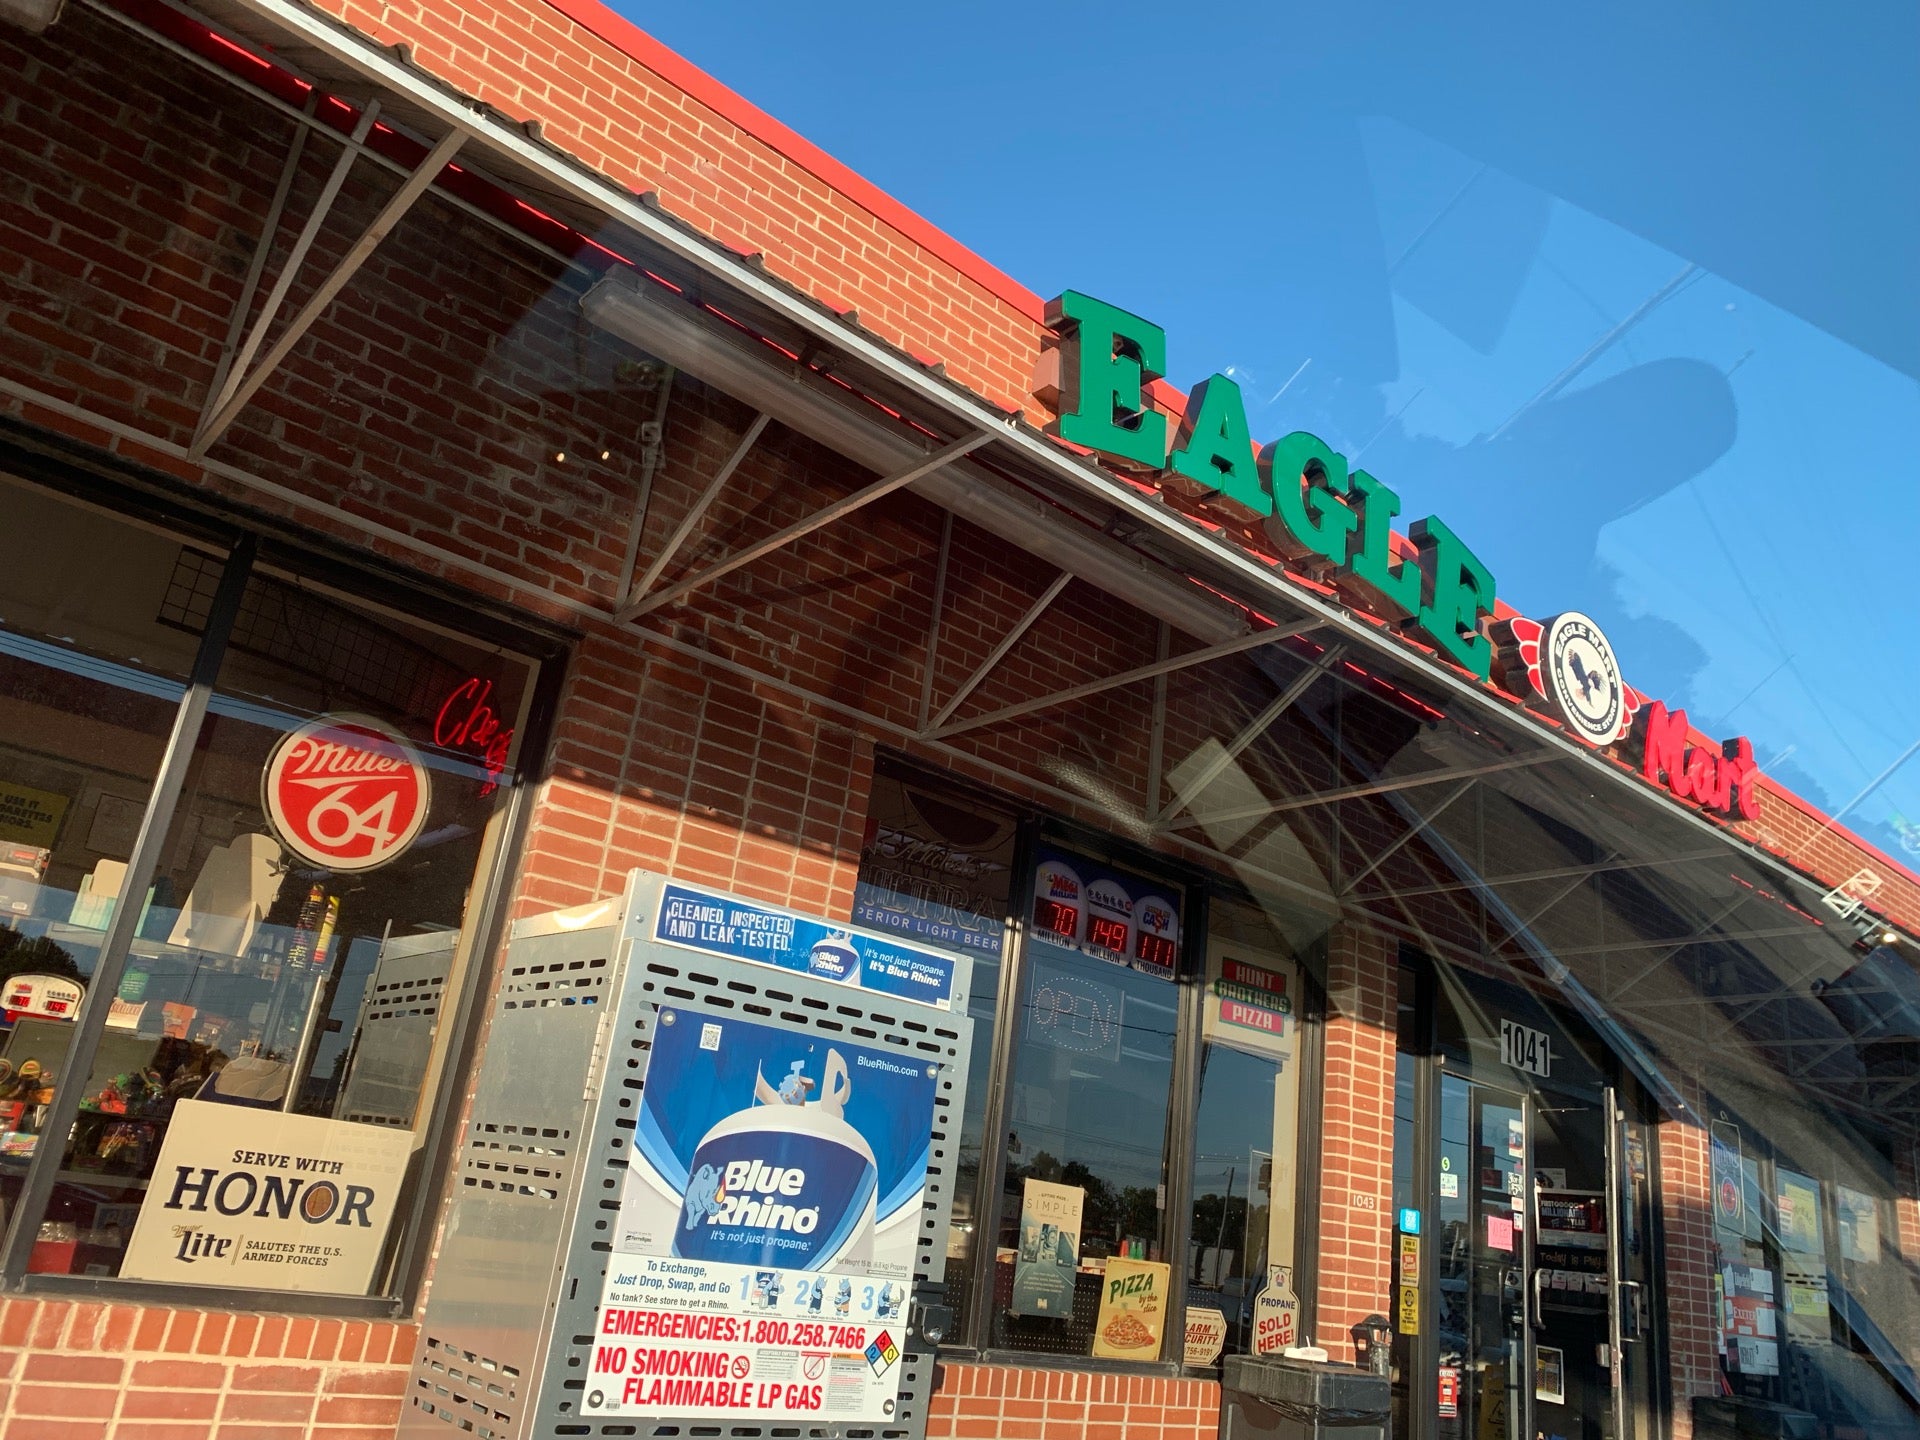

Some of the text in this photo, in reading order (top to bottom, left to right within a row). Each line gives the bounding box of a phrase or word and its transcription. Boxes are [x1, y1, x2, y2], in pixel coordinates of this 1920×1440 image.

[1046, 288, 1497, 683] EAGLE
[1555, 622, 1617, 688] EAGLE MART
[1556, 667, 1617, 732] CONVENIENCE STORE
[287, 737, 411, 775] Miller
[1643, 699, 1762, 821] Mart
[307, 784, 398, 855] 64
[670, 901, 794, 937] CLEANED, INSPECTED,
[1052, 903, 1075, 936] 70
[669, 919, 791, 952] AND LEAK-TESTED.
[916, 921, 958, 940] LIGHT
[964, 933, 1000, 951] BEER
[1037, 928, 1070, 948] MILLION
[1092, 919, 1125, 952] 149
[819, 951, 840, 962] Blue
[865, 947, 946, 978] It's not just propane.
[1089, 945, 1120, 964] MILLION
[1141, 935, 1172, 966] 111
[815, 960, 845, 973] Rhino
[869, 960, 885, 973] It's
[886, 965, 909, 979] Blue
[1136, 960, 1172, 979] THOUSAND
[1236, 965, 1274, 989] HUNT
[1219, 981, 1288, 1012] BROTHERS
[1036, 987, 1112, 1042] OPEN
[1232, 1004, 1272, 1030] PIZZA
[1503, 1022, 1549, 1076] 1041
[857, 1055, 919, 1078] BlueRhino.com
[232, 1149, 344, 1175] SERVE WITH
[725, 1159, 805, 1196] Blue
[163, 1165, 375, 1228] HONOR
[1026, 1198, 1079, 1217] SIMPLE
[1353, 1194, 1375, 1209] 1043
[707, 1196, 819, 1234] Rhino
[175, 1231, 232, 1264] Lite
[246, 1240, 343, 1257] SALUTES THE U.S.
[710, 1230, 810, 1251] It's not just propane.
[242, 1252, 329, 1267] ARMED FORCES
[647, 1260, 707, 1278] To Exchange,
[614, 1273, 731, 1294] Just Drop, Swap, and Go
[740, 1275, 750, 1300] 1
[794, 1280, 810, 1305] 2
[1109, 1273, 1154, 1304] PIZZA
[610, 1292, 620, 1302] No
[622, 1293, 643, 1303] tank?
[645, 1294, 658, 1304] See
[659, 1297, 678, 1306] store
[680, 1298, 687, 1306] to
[688, 1299, 701, 1310] get
[708, 1300, 730, 1310] Rhino.
[860, 1286, 875, 1311] 3
[1138, 1292, 1158, 1308] by the
[1143, 1304, 1157, 1313] slice
[1261, 1297, 1296, 1310] PROPANE
[602, 1308, 866, 1350] EMERGENCIES: 1.800.258.7466
[1258, 1312, 1291, 1335] SOLD
[879, 1335, 887, 1348] 4
[1257, 1329, 1295, 1353] HERE!
[594, 1346, 628, 1374] NO
[631, 1348, 730, 1379] SMOKING
[869, 1347, 895, 1361] 2 0
[622, 1377, 753, 1408] FLAMMABLE
[757, 1383, 782, 1409] LP
[785, 1384, 823, 1411] GAS
